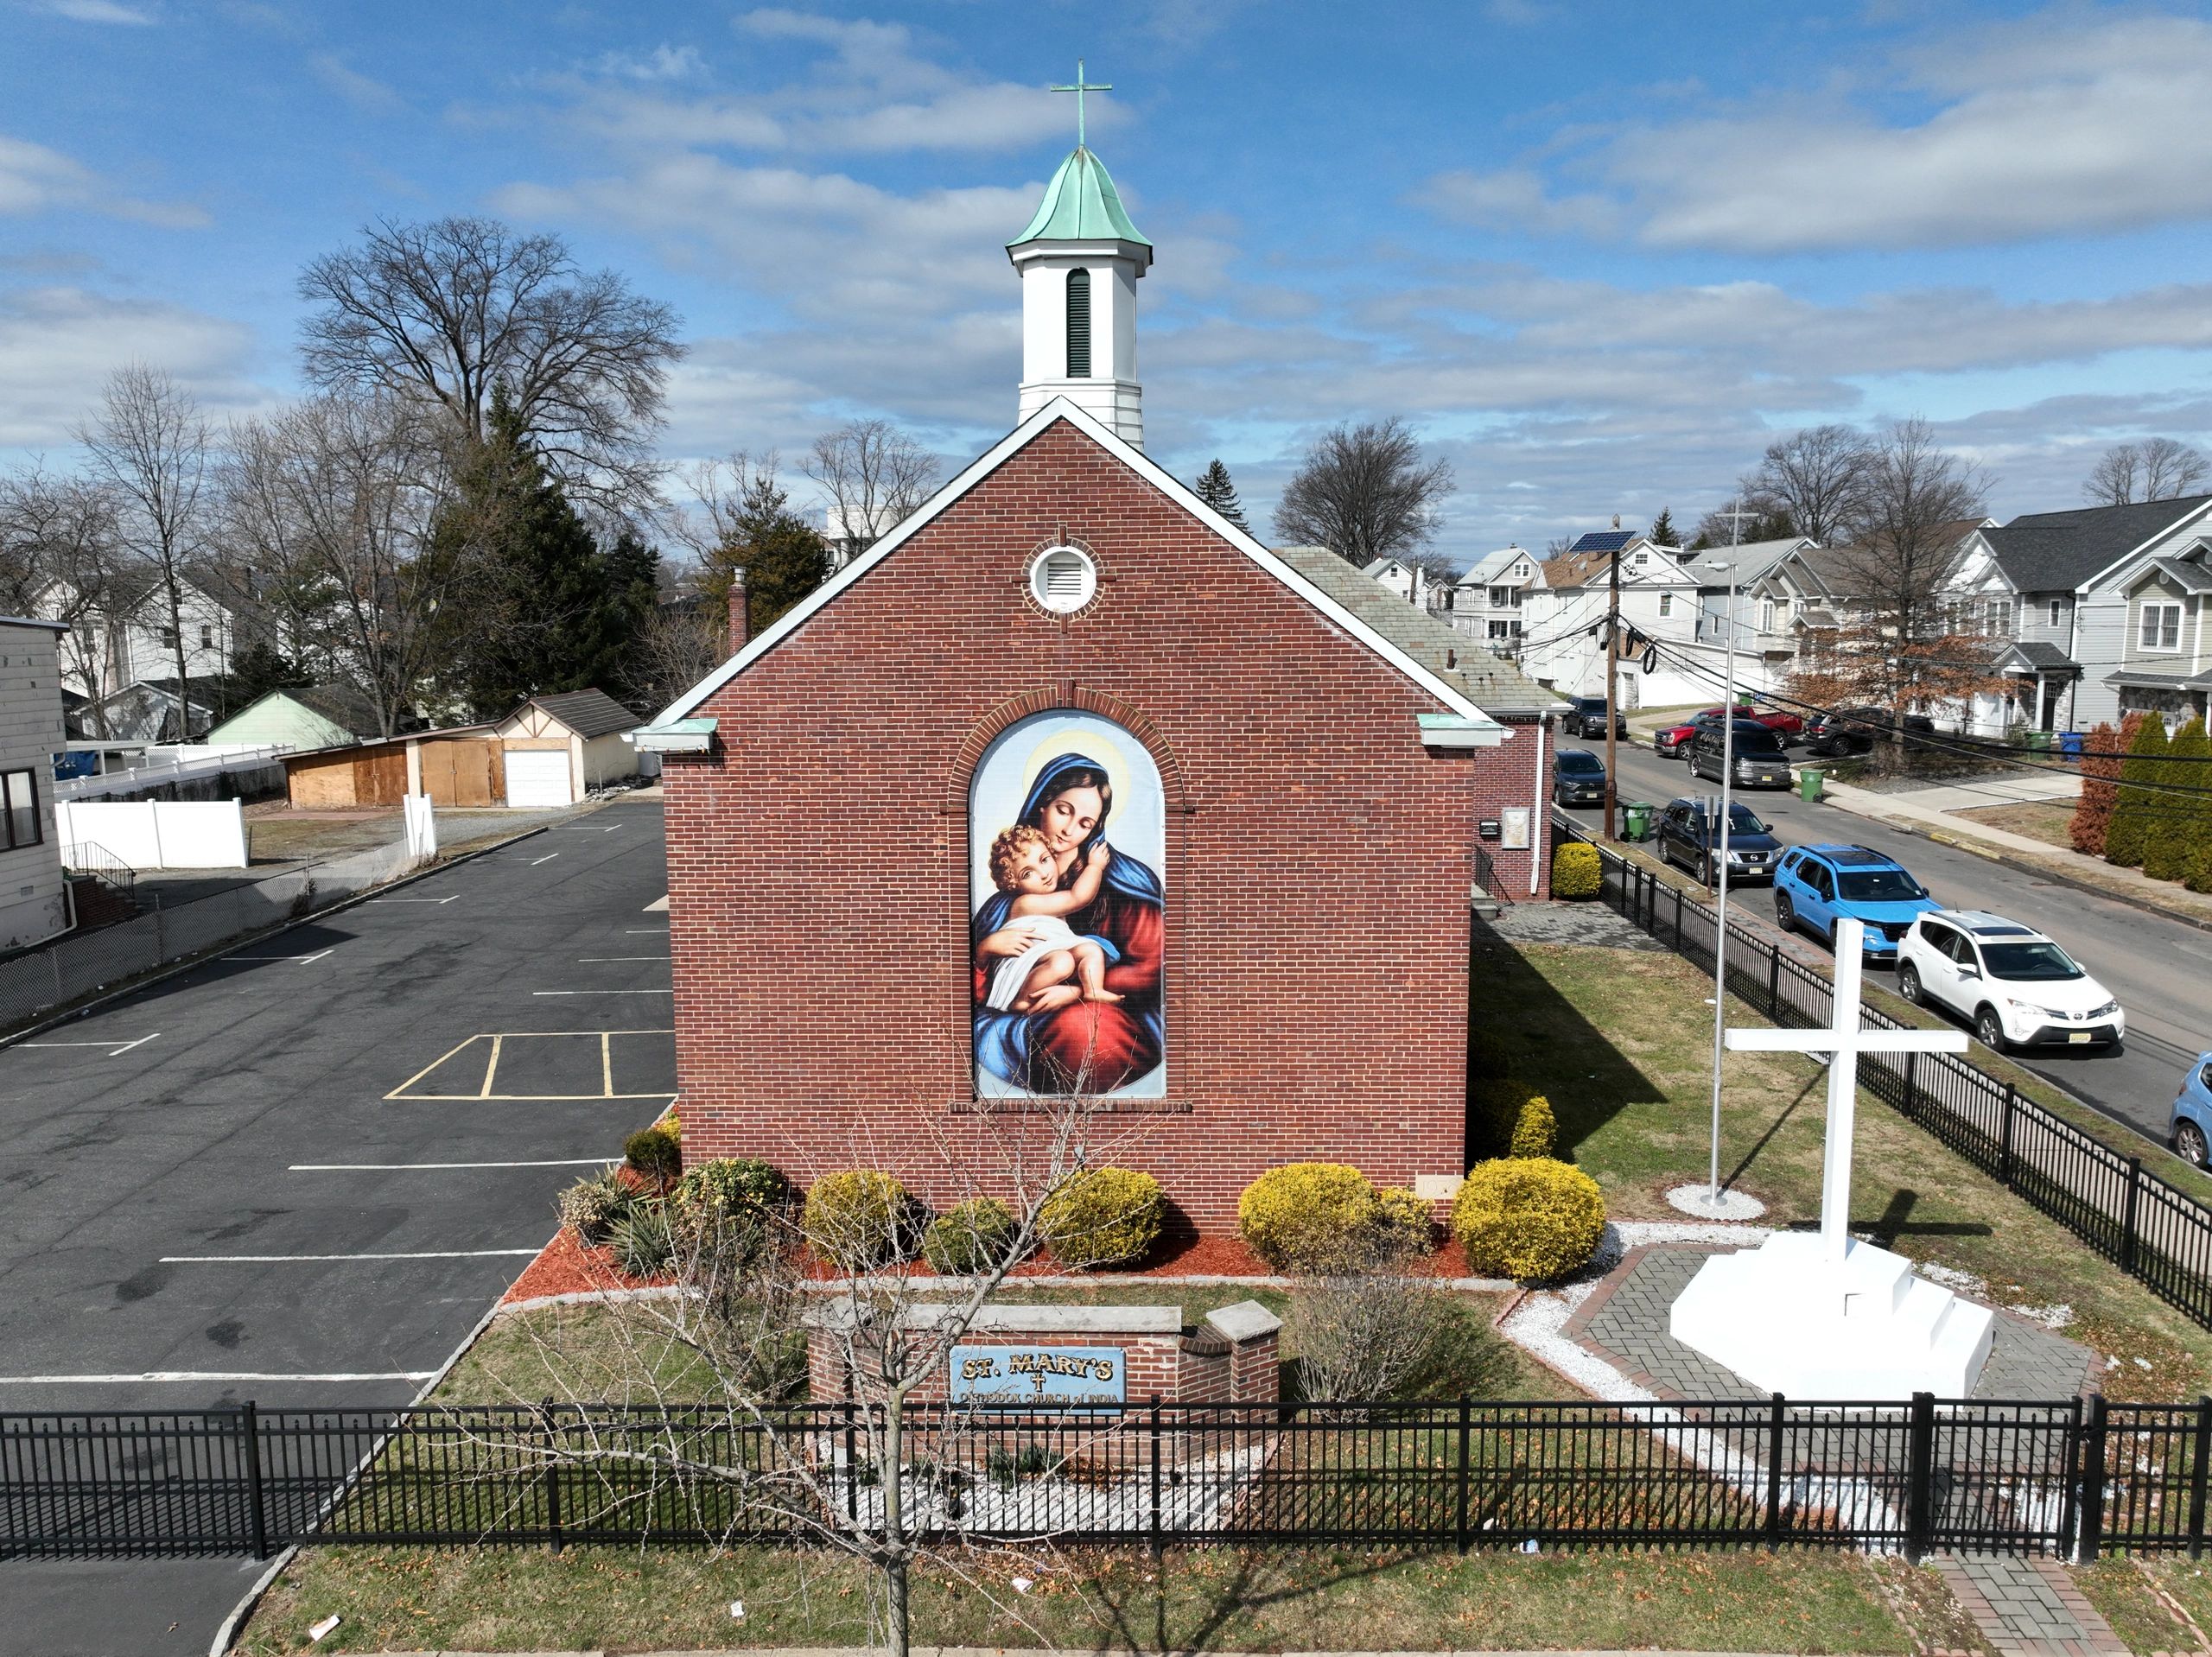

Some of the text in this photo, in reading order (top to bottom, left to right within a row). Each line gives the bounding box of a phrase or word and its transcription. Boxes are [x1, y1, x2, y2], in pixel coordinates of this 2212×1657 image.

[962, 1353, 1113, 1381] ST. MARY'S
[1025, 1394, 1070, 1403] CHURCH
[1088, 1394, 1118, 1403] INDIA
